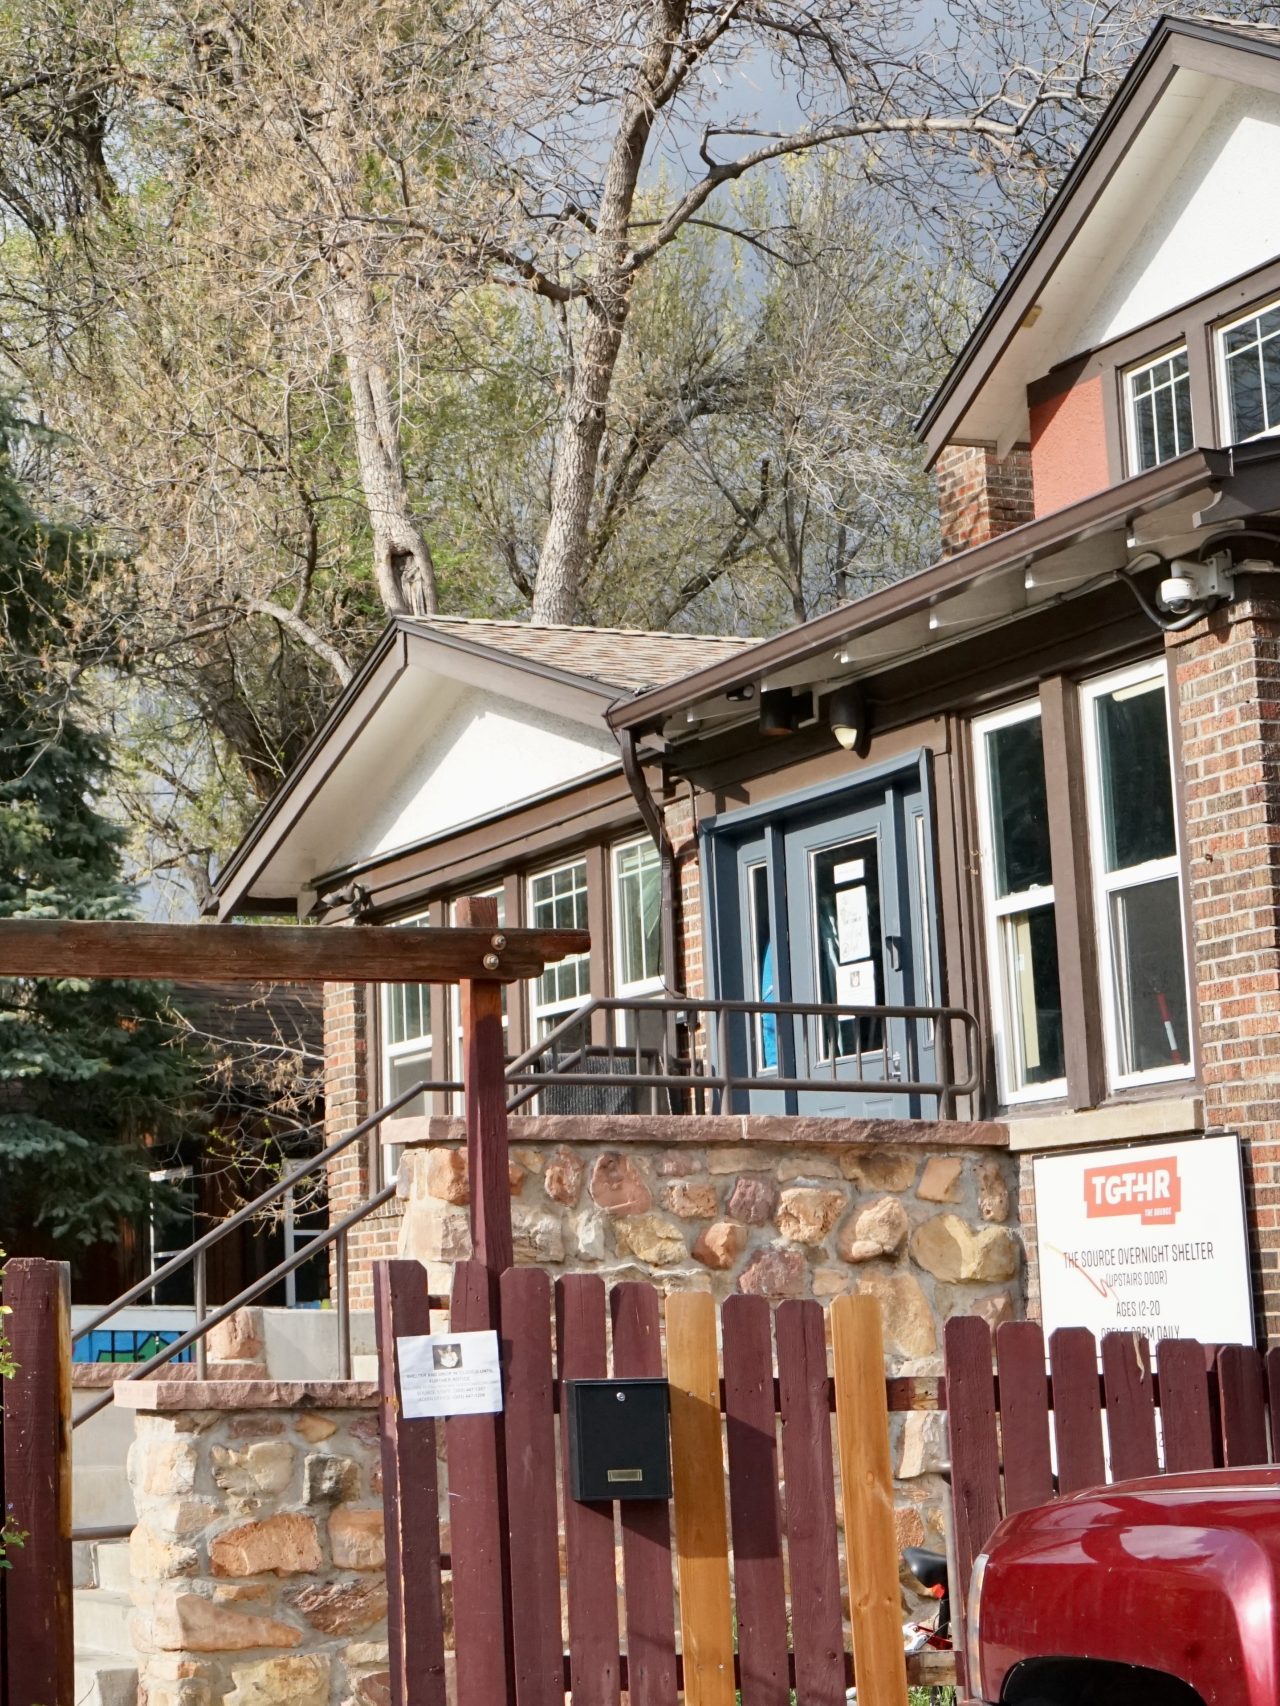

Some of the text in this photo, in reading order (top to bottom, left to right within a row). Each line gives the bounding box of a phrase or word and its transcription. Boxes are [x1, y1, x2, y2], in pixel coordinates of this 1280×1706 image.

[1063, 1241, 1214, 1269] THE SOURCE OVERNIGHT SHELTER
[1105, 1269, 1168, 1288] (UPSTAIRS DOOR)
[1116, 1300, 1161, 1318] AGES 12-20
